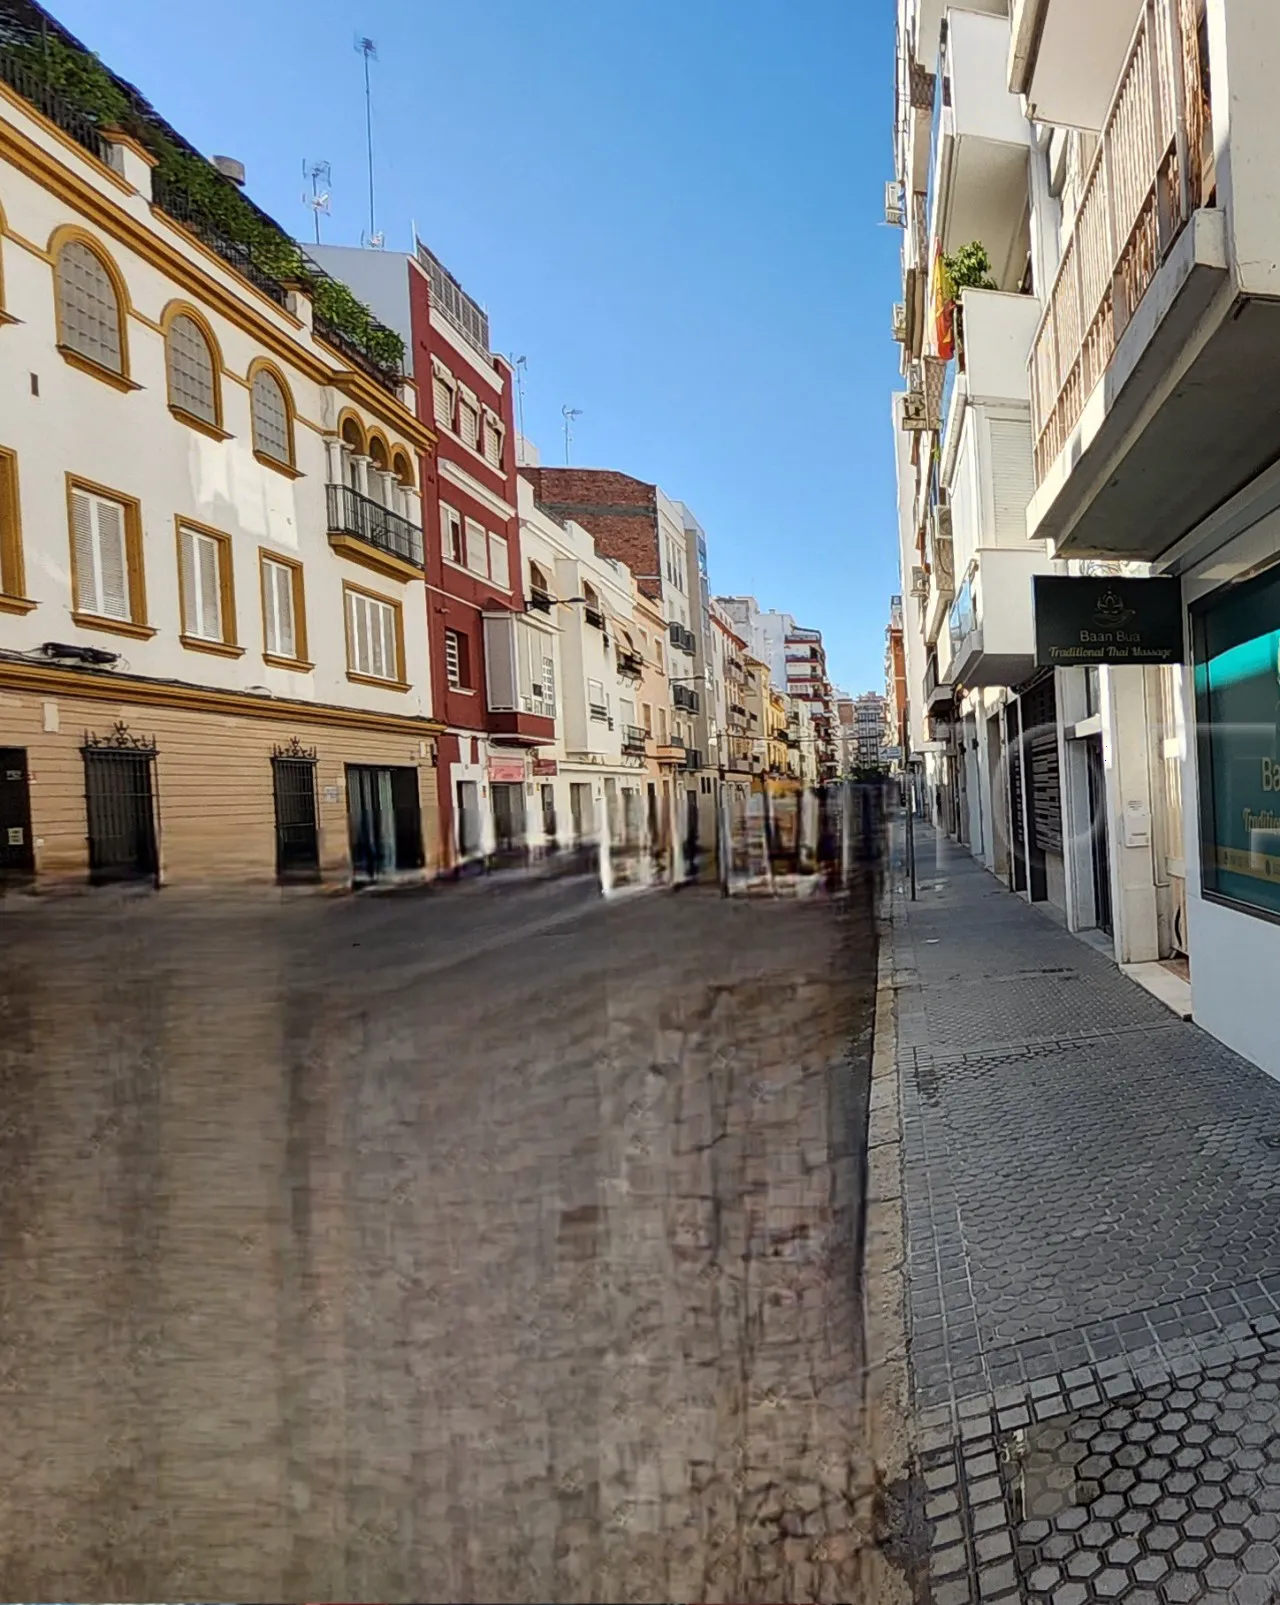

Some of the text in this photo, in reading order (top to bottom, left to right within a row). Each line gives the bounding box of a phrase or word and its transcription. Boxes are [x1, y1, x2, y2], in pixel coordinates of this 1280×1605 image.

[1079, 630, 1141, 642] Baan Bua
[1049, 646, 1172, 659] Traditional Thai Massage
